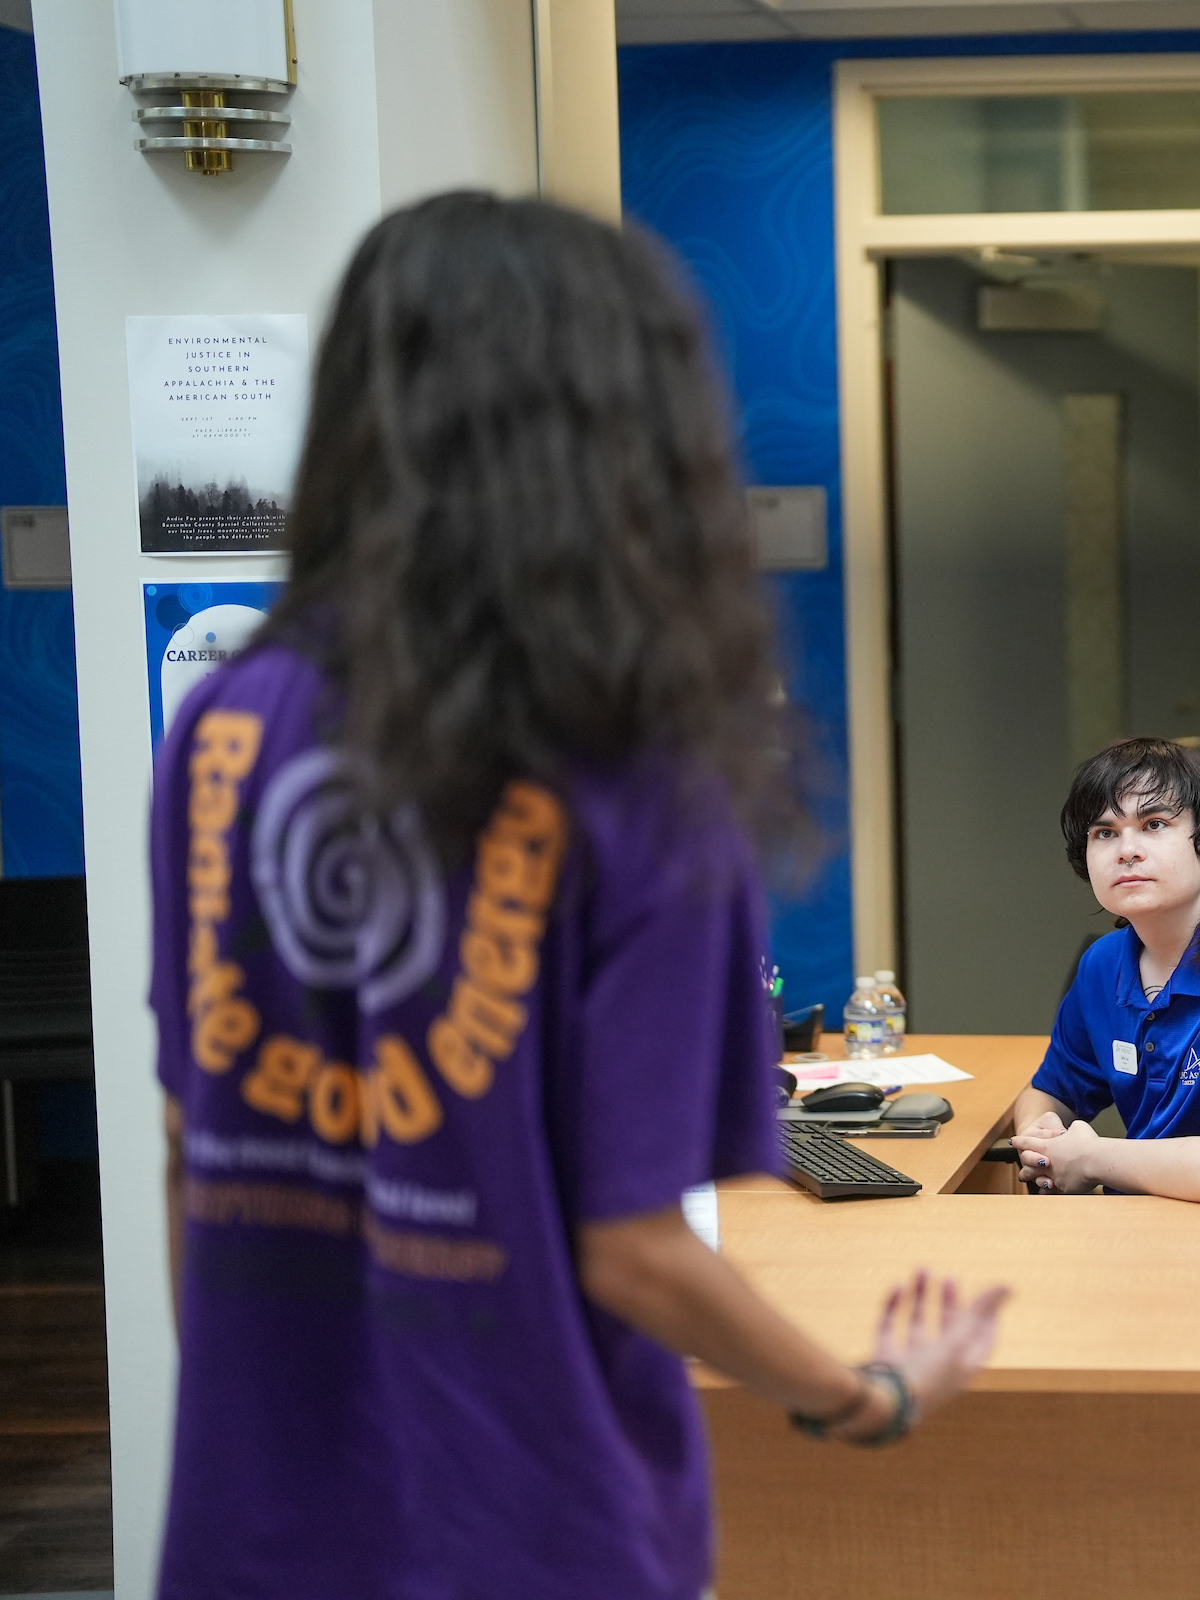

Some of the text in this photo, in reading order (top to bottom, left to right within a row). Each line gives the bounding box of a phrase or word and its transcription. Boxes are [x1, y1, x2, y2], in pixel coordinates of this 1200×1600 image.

[168, 337, 267, 345] ENVIRONMENTAL
[186, 351, 231, 360] JUSTICE
[188, 365, 249, 373] SOUTHERN
[166, 650, 227, 662] CAREER
